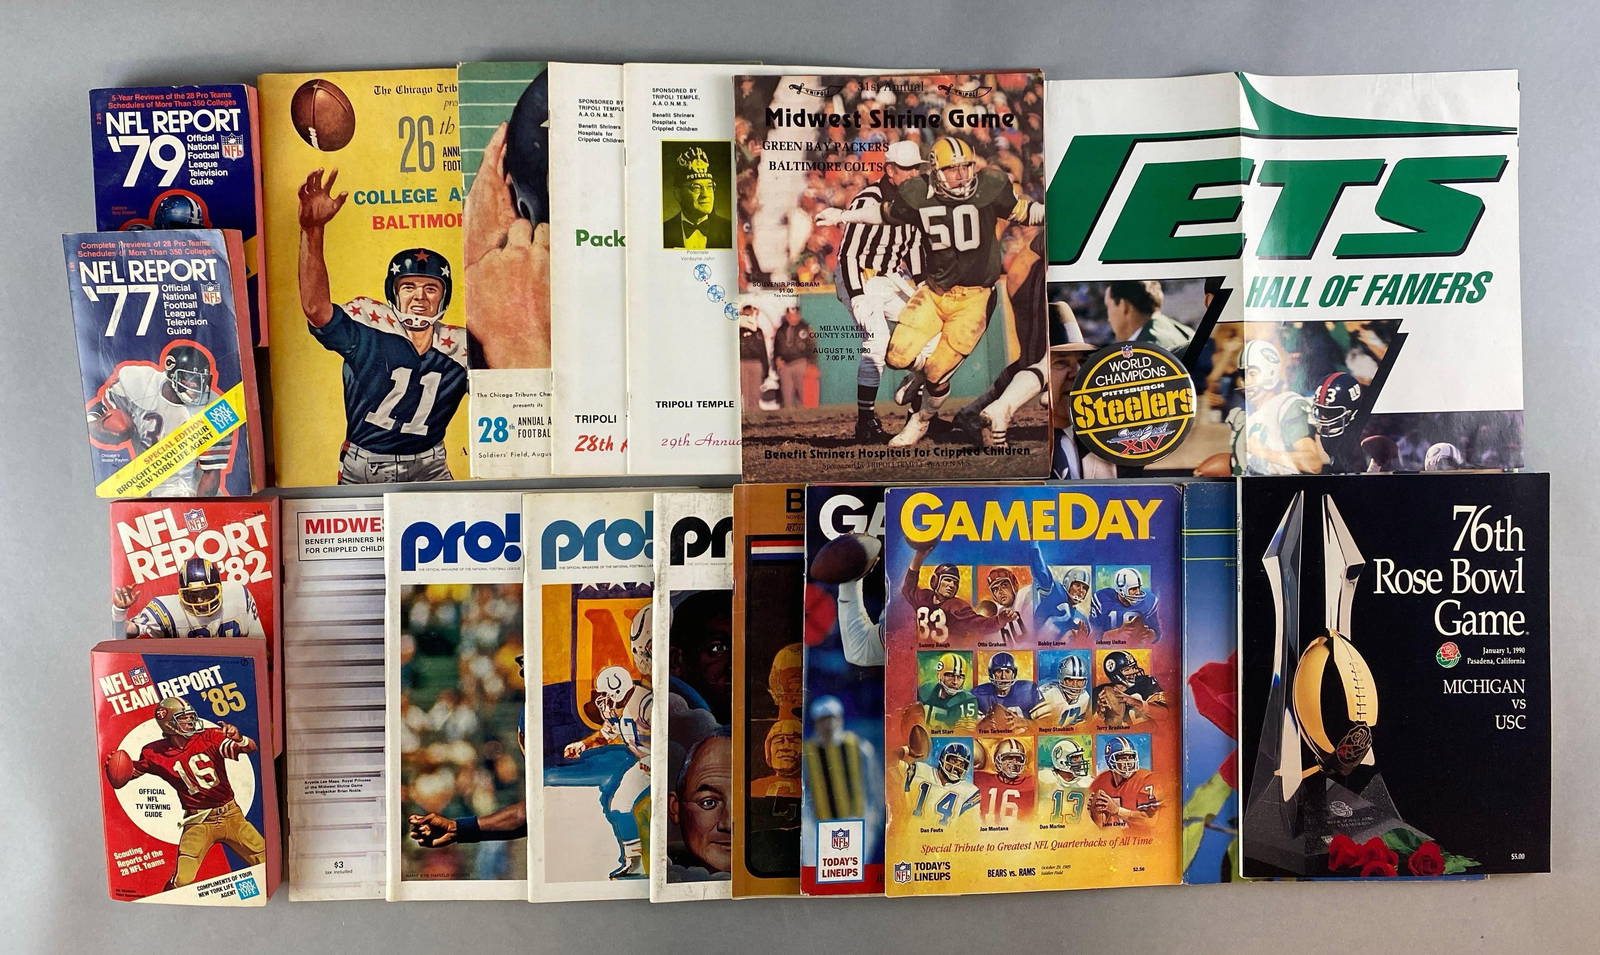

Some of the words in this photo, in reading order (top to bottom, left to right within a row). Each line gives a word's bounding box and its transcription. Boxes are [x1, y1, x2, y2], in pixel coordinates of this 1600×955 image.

[374, 85, 392, 96] The
[395, 84, 433, 96] Chicago
[884, 81, 924, 93] Annual
[578, 98, 614, 106] SPONSORED
[105, 111, 149, 134] NFL
[152, 109, 241, 133] REPORT
[765, 108, 862, 129] Midwest
[870, 109, 941, 129] Shrine
[948, 109, 1015, 128] Game
[187, 134, 215, 142] Official
[398, 115, 435, 172] 26
[187, 142, 219, 151] National
[762, 141, 802, 152] GREEN
[805, 141, 833, 152] BAY
[834, 142, 890, 153] PACKERS
[108, 135, 186, 188] '79
[188, 151, 220, 159] Football
[188, 160, 218, 169] League
[768, 161, 842, 172] BALTIMORE
[843, 161, 884, 172] COLTS
[189, 169, 228, 177] Television
[190, 178, 214, 186] Guide
[353, 188, 437, 206] COLLEGE
[919, 204, 981, 252] 50
[575, 229, 626, 247] Pack
[79, 261, 125, 283] NFL
[128, 259, 217, 282] REPORT
[161, 284, 191, 292] Official
[1245, 274, 1312, 308] HALL
[1318, 275, 1359, 307] OF
[1361, 271, 1494, 306] FAMERS
[163, 292, 197, 300] National
[82, 285, 159, 336] '77
[164, 301, 198, 309] Football
[165, 310, 196, 318] League
[166, 318, 208, 326] Television
[167, 327, 192, 335] Guide
[1109, 356, 1152, 372] WORLD
[1095, 365, 1167, 387] CHAMPIONS
[1102, 382, 1165, 398] PITTSBURGH
[365, 367, 443, 436] 11
[655, 401, 693, 409] TRIPOLI
[696, 400, 735, 408] TEMPLE
[1073, 386, 1194, 429] Steelers
[518, 416, 545, 426] ANNUAL
[575, 415, 617, 424] TRIPOLI
[518, 429, 551, 438] FOOTBAL
[144, 441, 176, 465] SPECIAL
[174, 418, 205, 441] EDITION
[575, 434, 613, 452] 28th
[661, 433, 691, 450] 29th
[1119, 434, 1165, 455] XIV
[116, 468, 151, 495] BROUGHT
[152, 459, 163, 471] TO
[162, 447, 180, 462] YOU
[179, 440, 190, 451] BY
[187, 425, 210, 443] YOUR
[764, 449, 807, 460] Benefit
[809, 449, 855, 459] Shriners
[858, 448, 911, 461] Hospitals
[914, 447, 931, 458] for
[933, 447, 980, 459] Crippled
[983, 446, 1030, 456] Children
[136, 476, 153, 491] NEW
[153, 461, 175, 479] YORK
[174, 449, 190, 465] LIFE
[190, 432, 215, 453] AGENT
[900, 491, 1164, 543] GAMEDAY
[117, 508, 189, 553] NFL
[1453, 504, 1526, 552] 76th
[305, 537, 335, 545] BENEFIT
[401, 512, 522, 572] pro!
[127, 514, 270, 584] REPORT
[305, 546, 320, 554] FOR
[322, 545, 358, 553] CRIPPLED
[218, 550, 273, 586] '82
[1373, 558, 1444, 595] Rose
[1450, 556, 1526, 594] Bowl
[1434, 599, 1526, 637] Game
[1482, 646, 1506, 655] January
[1506, 647, 1512, 655] 1,
[1512, 646, 1526, 654] 1990
[1467, 657, 1495, 666] Pasadena,
[1496, 657, 1526, 665] California
[98, 672, 134, 697] NFL
[107, 685, 160, 715] TEAM
[157, 665, 224, 699] REPORT
[1443, 679, 1526, 694] MICHIGAN
[201, 682, 247, 717] '85
[1511, 698, 1526, 710] vs
[1495, 715, 1527, 730] USC
[172, 753, 218, 796] 16
[920, 843, 952, 856] Special
[953, 843, 985, 853] Tribute
[986, 843, 995, 851] to
[997, 841, 1032, 851] Greatest
[1033, 840, 1049, 849] NFL
[1050, 837, 1107, 850] Quarterbacks
[1108, 836, 1118, 848] of
[1119, 836, 1130, 845] All
[1131, 836, 1153, 845] Time
[113, 847, 143, 860] Scouting
[116, 855, 143, 869] Reports
[143, 852, 152, 860] of
[151, 850, 163, 858] the
[1511, 852, 1526, 861] $5.00
[129, 865, 143, 873] NFL
[143, 859, 165, 870] Teams
[334, 860, 344, 869] $3
[822, 856, 859, 867] TODAY'S
[914, 861, 951, 870] TODAY'S
[821, 868, 858, 878] LINEUPS
[914, 871, 951, 881] LINEUPS
[987, 868, 1008, 878] BEARS
[1018, 867, 1036, 876] RAMS
[196, 878, 232, 892] COMPLIMENTS
[198, 890, 209, 898] NEW
[210, 886, 223, 894] YORK
[220, 890, 237, 899] AGENT
